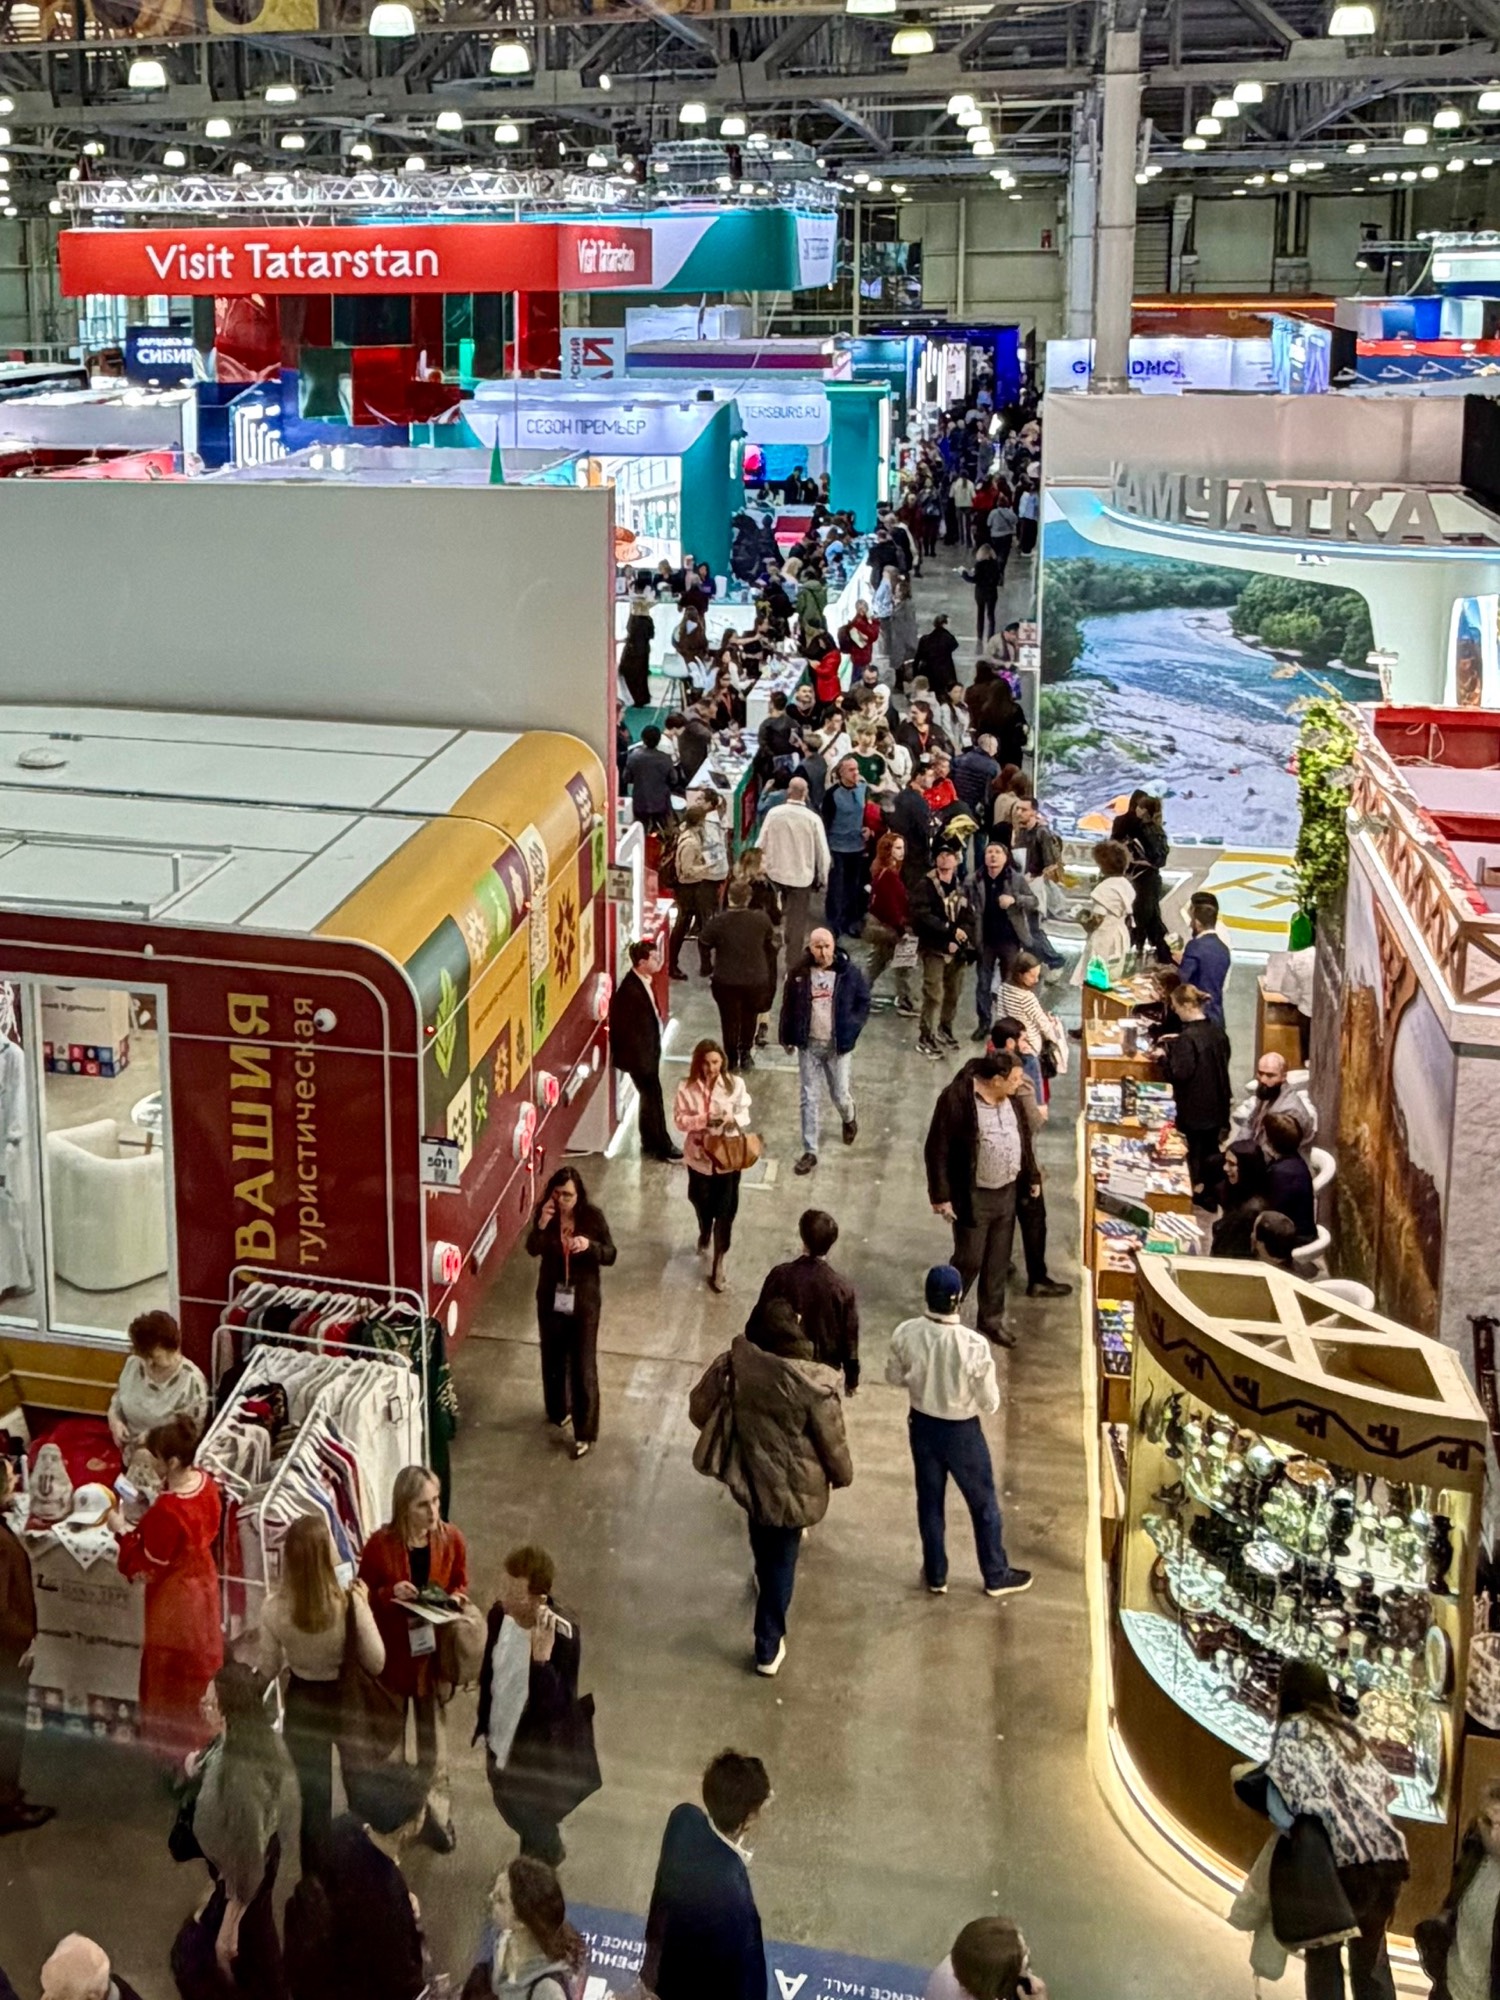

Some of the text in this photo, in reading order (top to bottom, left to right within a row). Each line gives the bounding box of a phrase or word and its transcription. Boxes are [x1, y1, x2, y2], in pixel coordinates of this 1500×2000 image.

[145, 243, 439, 280] Visit Tatarstan
[526, 418, 646, 435] СЕЗОН ПРЕМЬЕР
[227, 992, 277, 1282] ВАШИЯ
[293, 997, 328, 1266] туристическая
[774, 1968, 808, 2000] A
